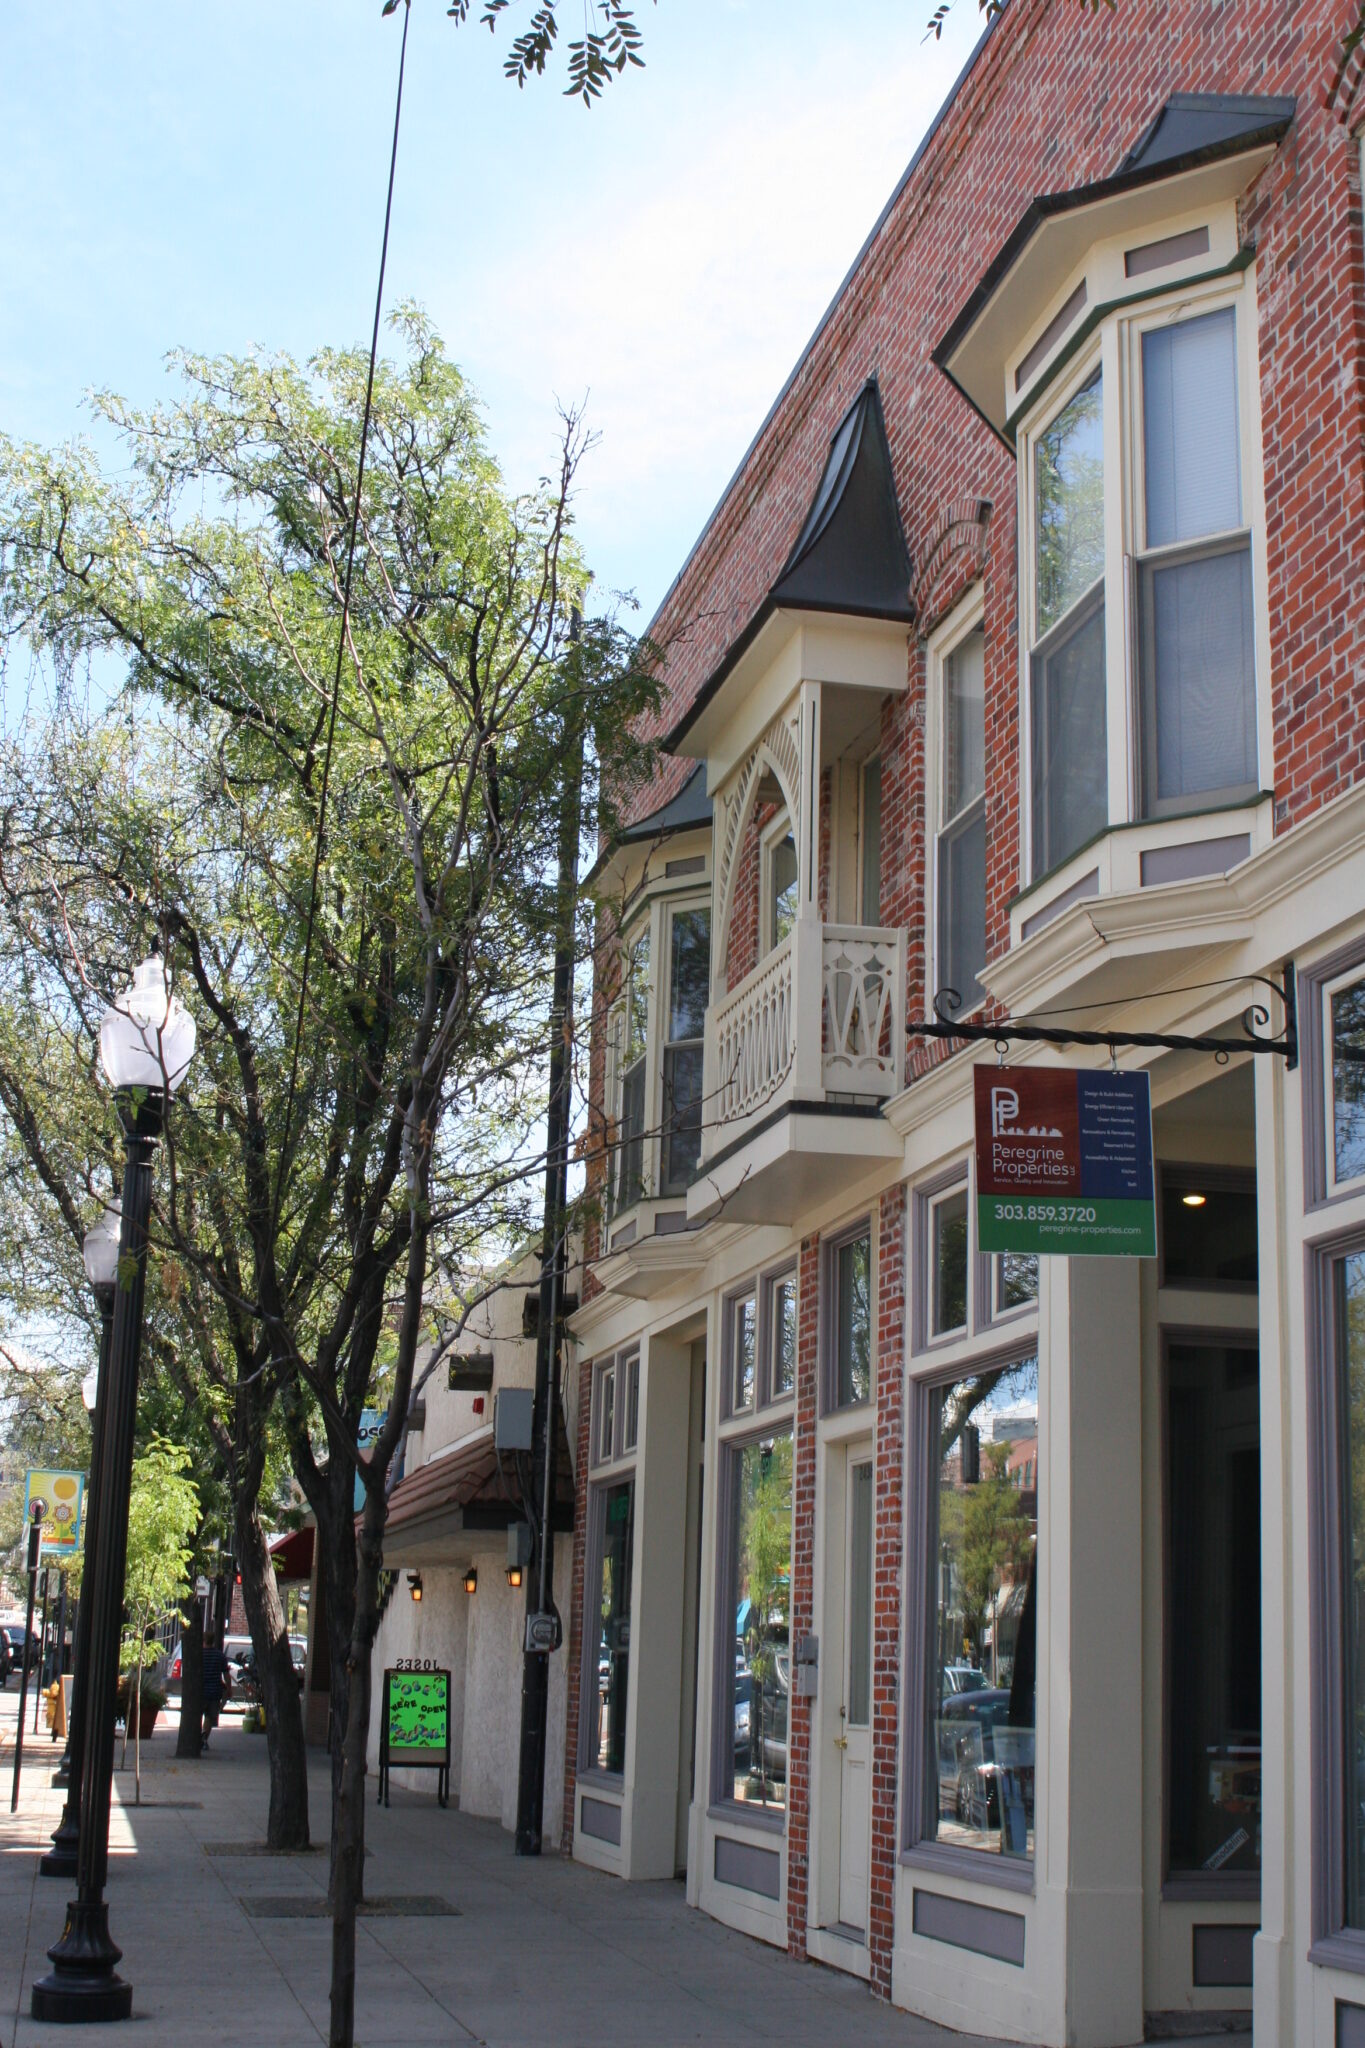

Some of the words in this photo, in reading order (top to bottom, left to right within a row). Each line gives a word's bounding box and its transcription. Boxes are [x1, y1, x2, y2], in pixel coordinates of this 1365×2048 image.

[992, 1142, 1065, 1164] Peregrine
[992, 1158, 1069, 1178] Properties
[1014, 1177, 1032, 1186] Quality
[994, 1203, 1097, 1223] 303.859.3720
[1039, 1224, 1142, 1235] peregrine-properties.com
